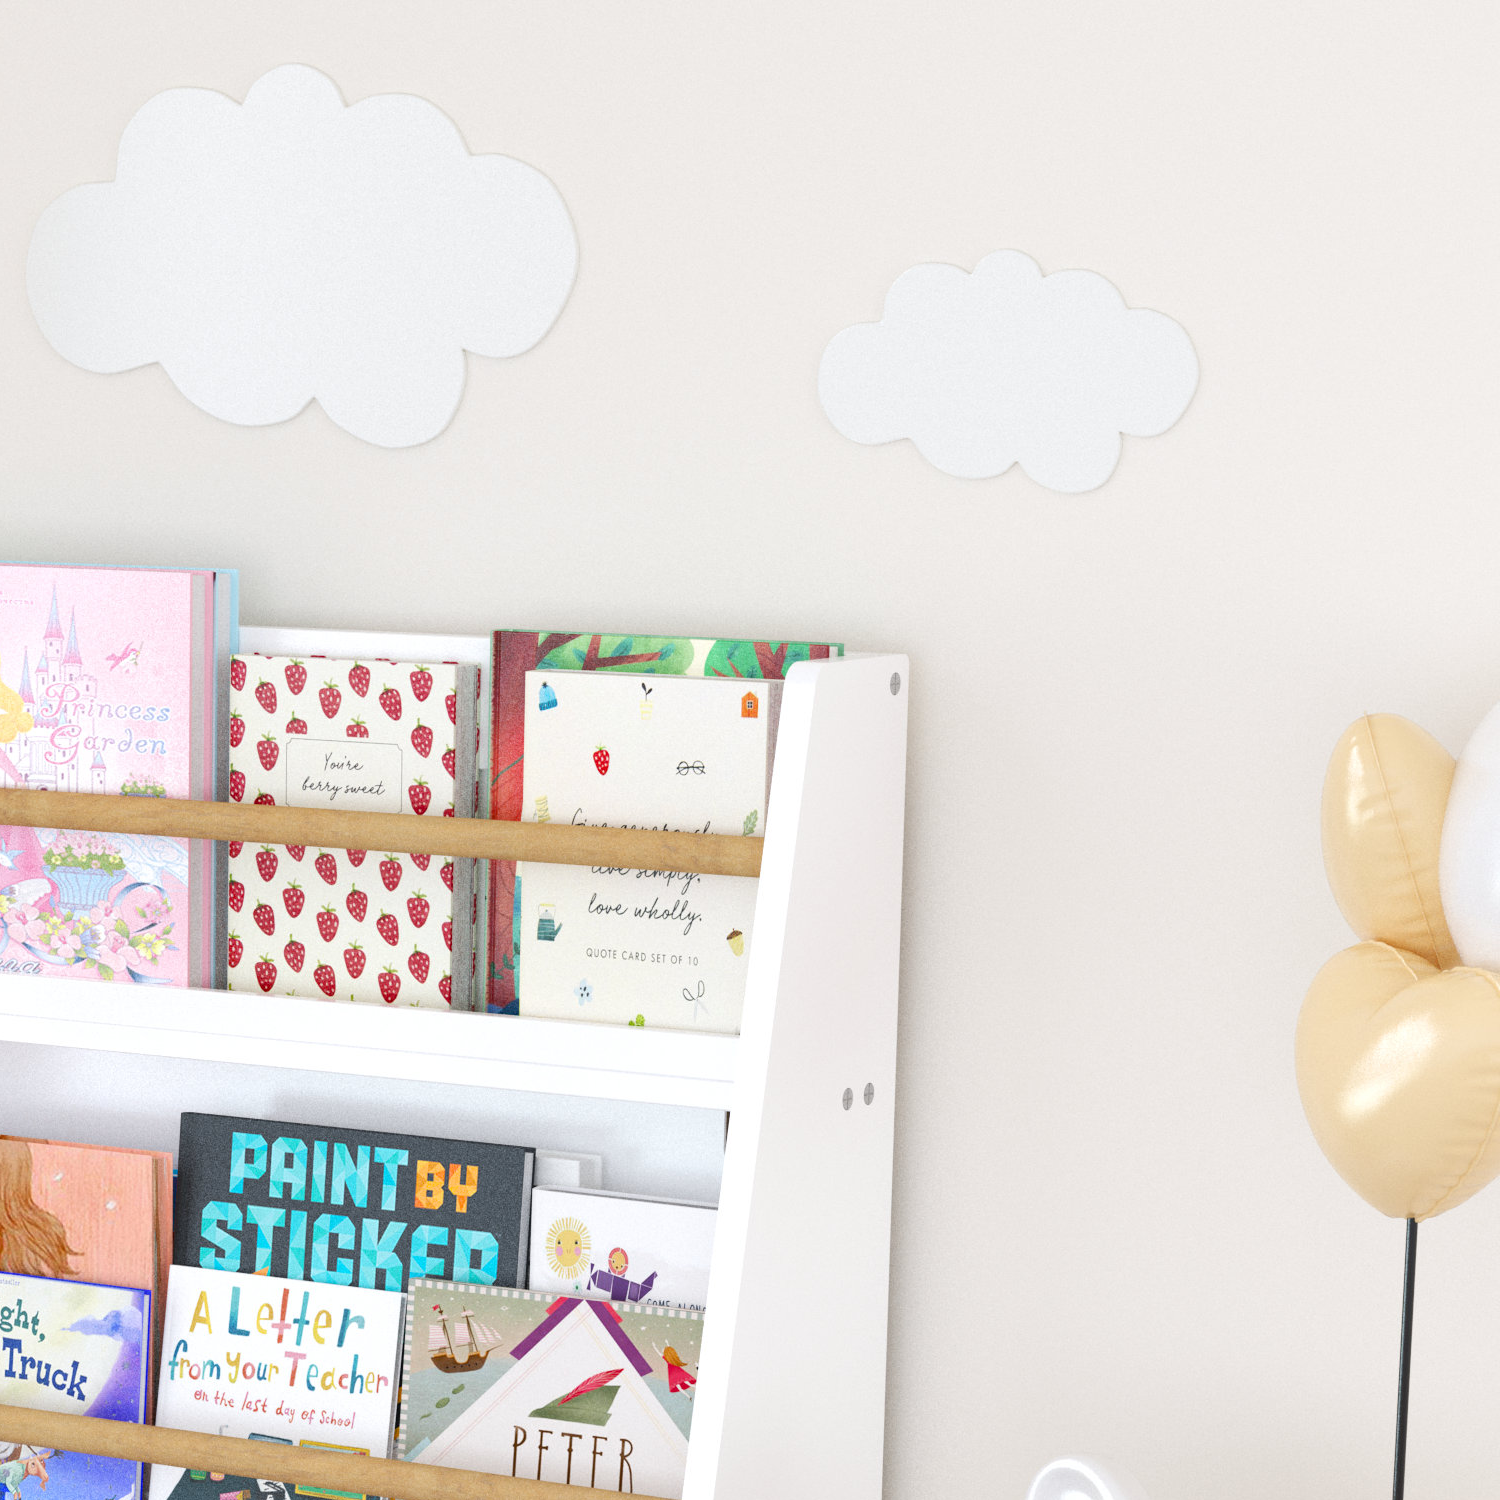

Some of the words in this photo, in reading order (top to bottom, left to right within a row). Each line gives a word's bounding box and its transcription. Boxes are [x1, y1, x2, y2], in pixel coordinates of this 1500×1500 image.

[41, 683, 170, 722] Princess
[44, 724, 167, 765] Garden
[324, 752, 364, 771] You're
[302, 776, 342, 801] berry
[344, 780, 386, 795] sweet
[587, 892, 628, 915] love
[634, 897, 702, 936] wholly.
[586, 948, 617, 960] QUOTE
[621, 950, 646, 962] CARD
[651, 953, 666, 963] SET
[670, 955, 683, 965] OF
[688, 956, 699, 966] 10
[228, 1131, 409, 1211] PAINT
[414, 1160, 479, 1213] BY
[199, 1200, 499, 1293] STICKER
[189, 1290, 212, 1335] A
[228, 1286, 366, 1347] Letter
[2, 1337, 88, 1402] Truck
[168, 1339, 221, 1381] from
[284, 1351, 389, 1394] Teacher
[194, 1389, 209, 1402] on
[214, 1391, 235, 1408] the
[241, 1392, 268, 1413] last
[275, 1400, 295, 1423] day
[301, 1409, 316, 1425] of
[513, 1426, 634, 1494] PETER
